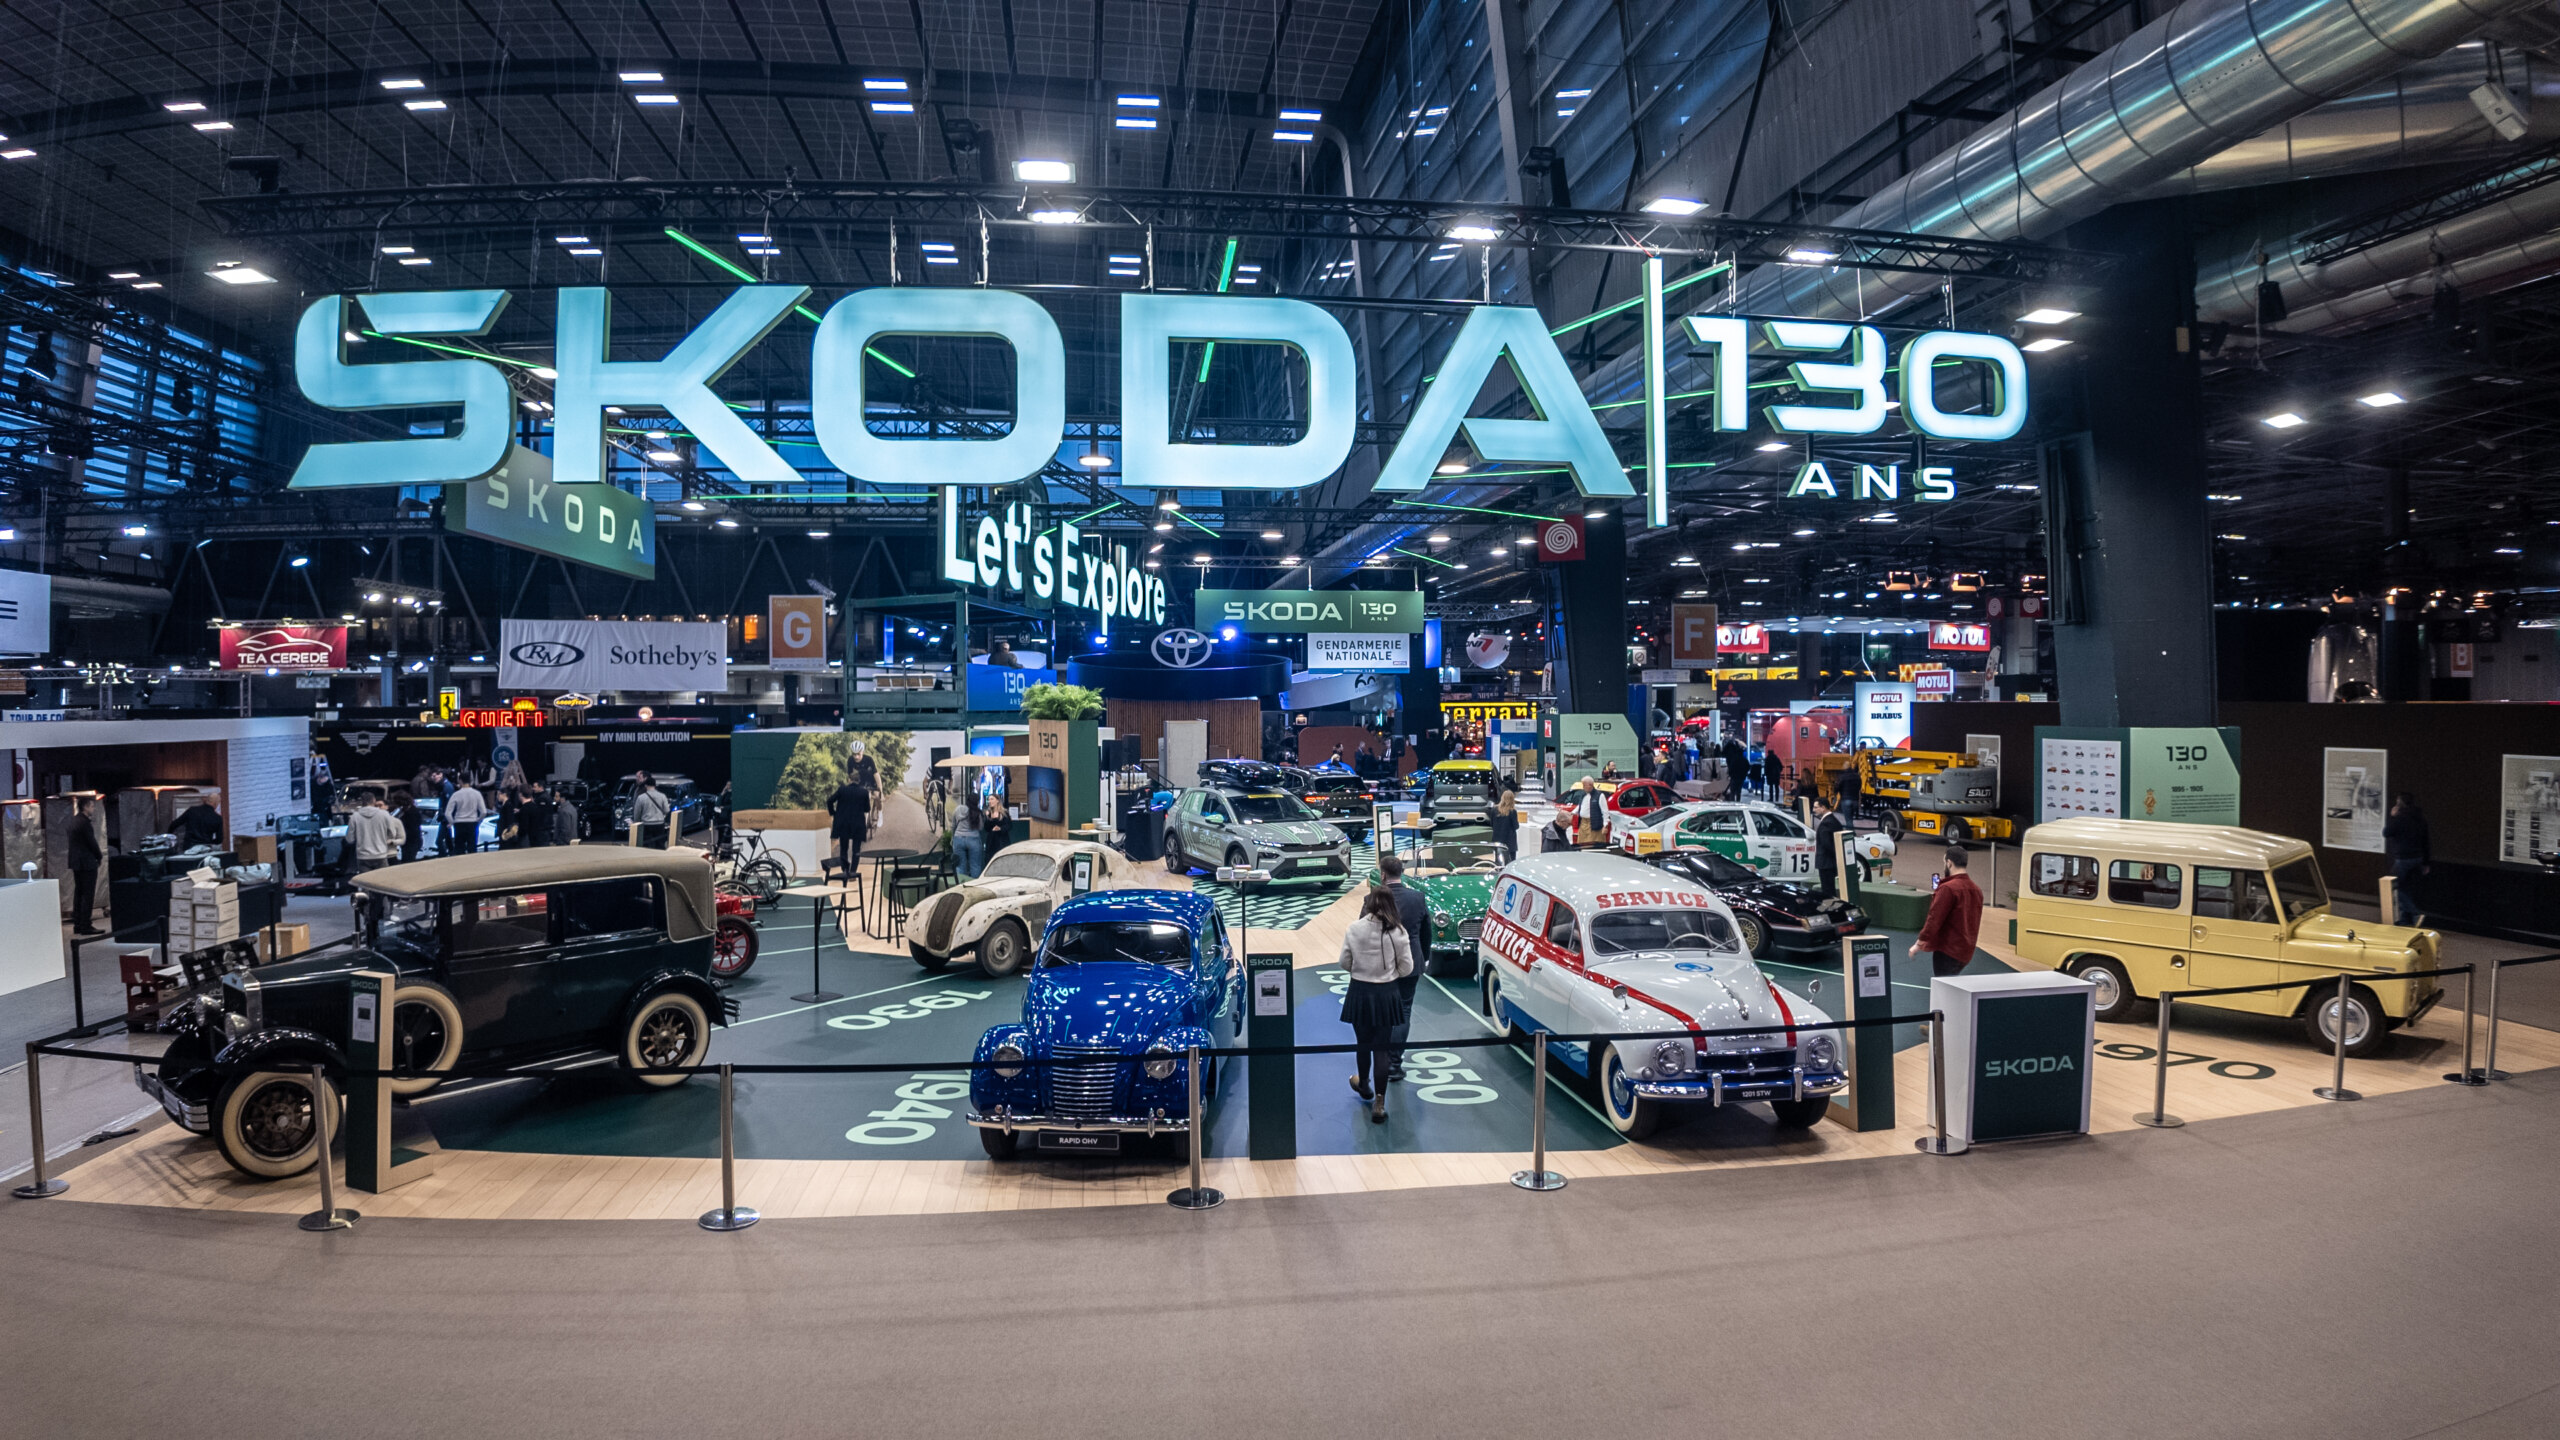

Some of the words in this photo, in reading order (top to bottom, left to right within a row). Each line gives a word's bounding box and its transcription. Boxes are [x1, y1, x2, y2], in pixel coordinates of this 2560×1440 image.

[289, 285, 1636, 498] SKODA
[1680, 315, 2029, 442] 130
[1789, 461, 1958, 501] ANS
[487, 467, 645, 554] SKODA
[944, 485, 1055, 599] Let's
[1061, 520, 1166, 636] Explore
[1224, 602, 1343, 621] SKODA
[1360, 603, 1397, 616] 130
[783, 611, 811, 648] G
[1684, 618, 1705, 651] F
[1933, 625, 1987, 646] MOTUL
[1316, 640, 1402, 650] GENDARMERIE
[238, 652, 268, 664] TEA
[270, 652, 329, 664] CEREDE
[610, 645, 717, 670] Sotheby's
[1326, 651, 1392, 661] NATIONALE
[1003, 672, 1025, 694] 130
[1916, 675, 1949, 688] MOTUL
[1872, 693, 1901, 702] MOTUL
[1587, 722, 1612, 731] 130
[600, 732, 613, 742] MY
[615, 732, 635, 742] MINI
[637, 732, 690, 742] REVOLUTION
[1038, 733, 1058, 749] 130
[2166, 746, 2207, 761] 130
[1791, 853, 1810, 873] 15
[1596, 892, 1709, 909] SERVICE
[1482, 917, 1535, 966] SERVICE
[1854, 943, 1888, 951] SKODA
[351, 980, 380, 990] SKODA
[826, 990, 993, 1030] 1930
[1985, 1055, 2074, 1078] SKODA
[2094, 1039, 2276, 1079] 970
[1401, 1047, 1499, 1105] 950
[1059, 1136, 1080, 1145] RAPID
[1082, 1136, 1098, 1145] OHV
